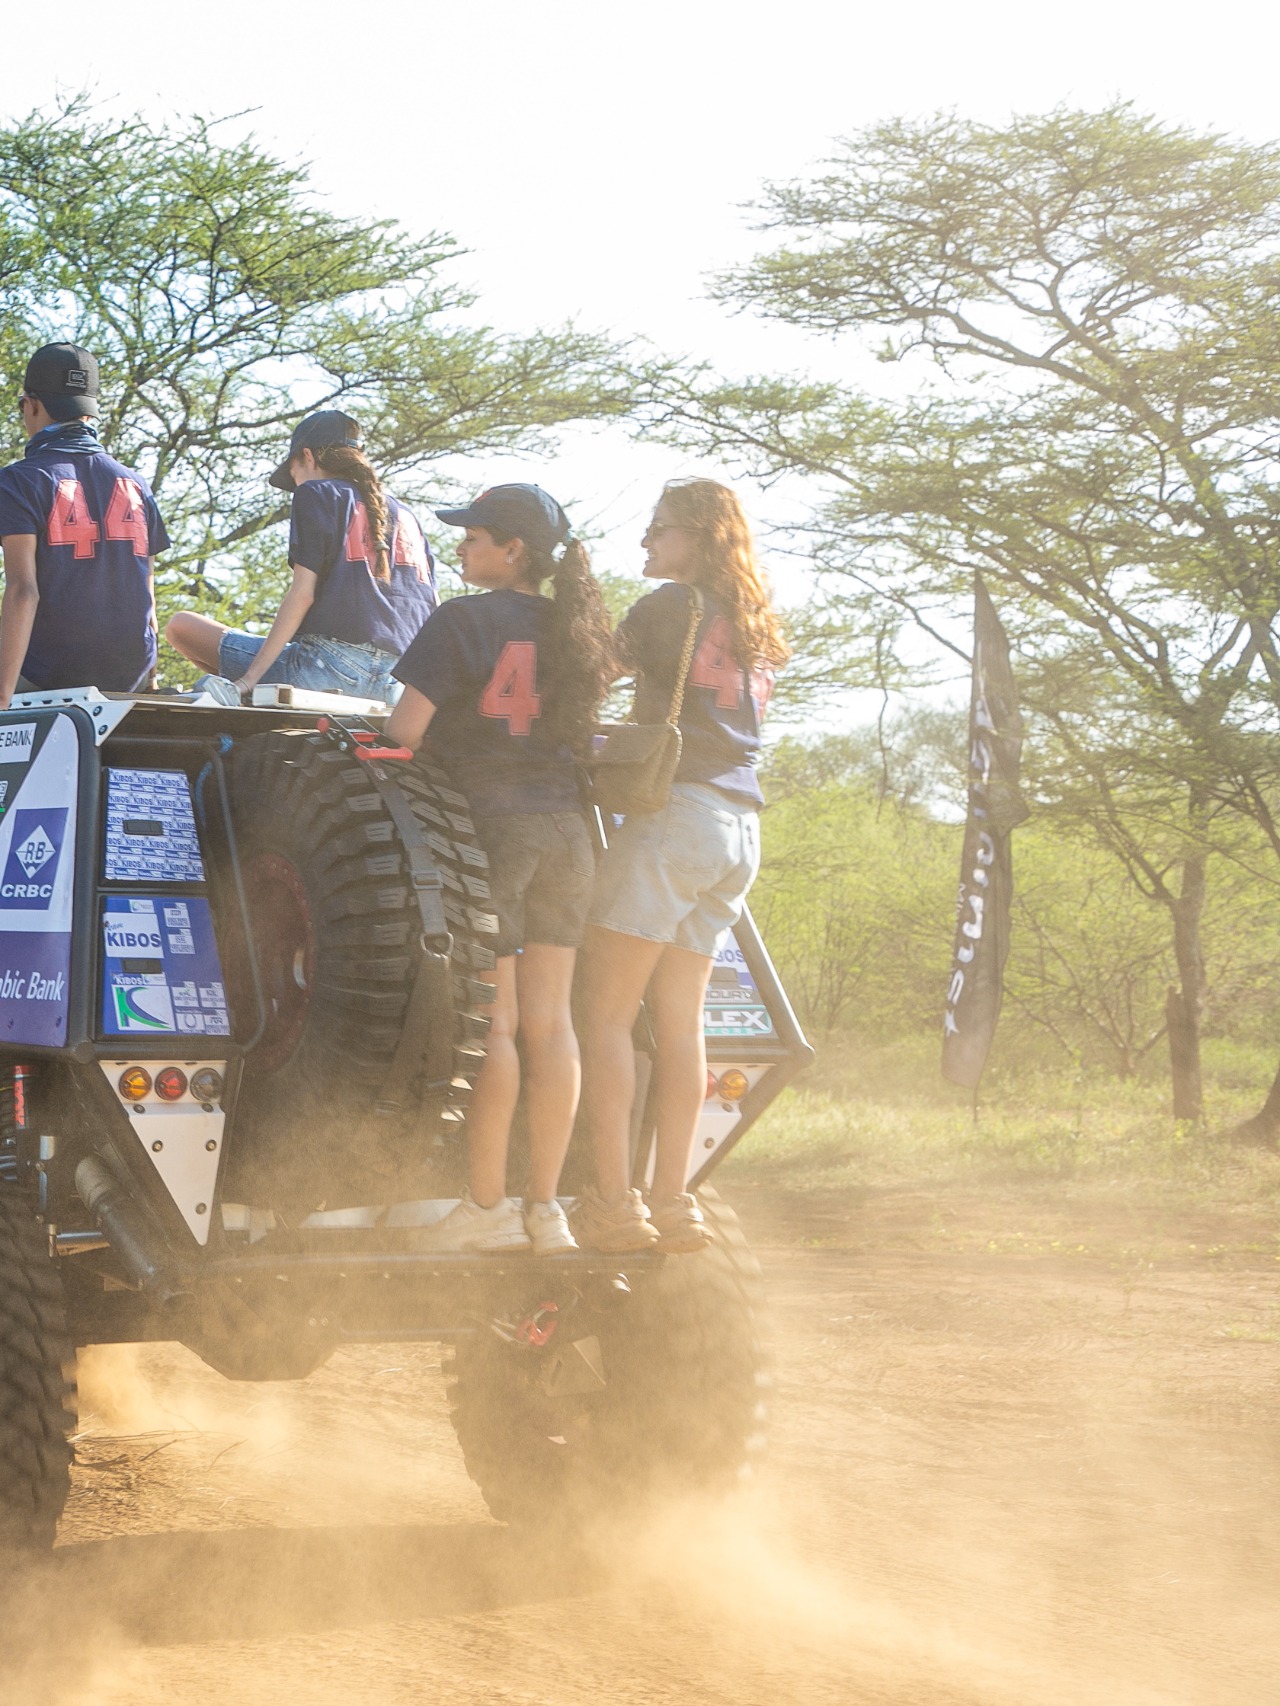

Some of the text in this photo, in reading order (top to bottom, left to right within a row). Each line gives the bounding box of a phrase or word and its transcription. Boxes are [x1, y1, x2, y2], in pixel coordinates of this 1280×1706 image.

[47, 477, 149, 560] 44
[478, 641, 542, 736] 4
[5, 729, 33, 747] BANK
[1, 883, 53, 898] CRBC
[107, 932, 161, 947] KIBOS
[716, 949, 744, 962] BOS
[27, 971, 65, 1001] Bank
[704, 1011, 769, 1031] LEX
